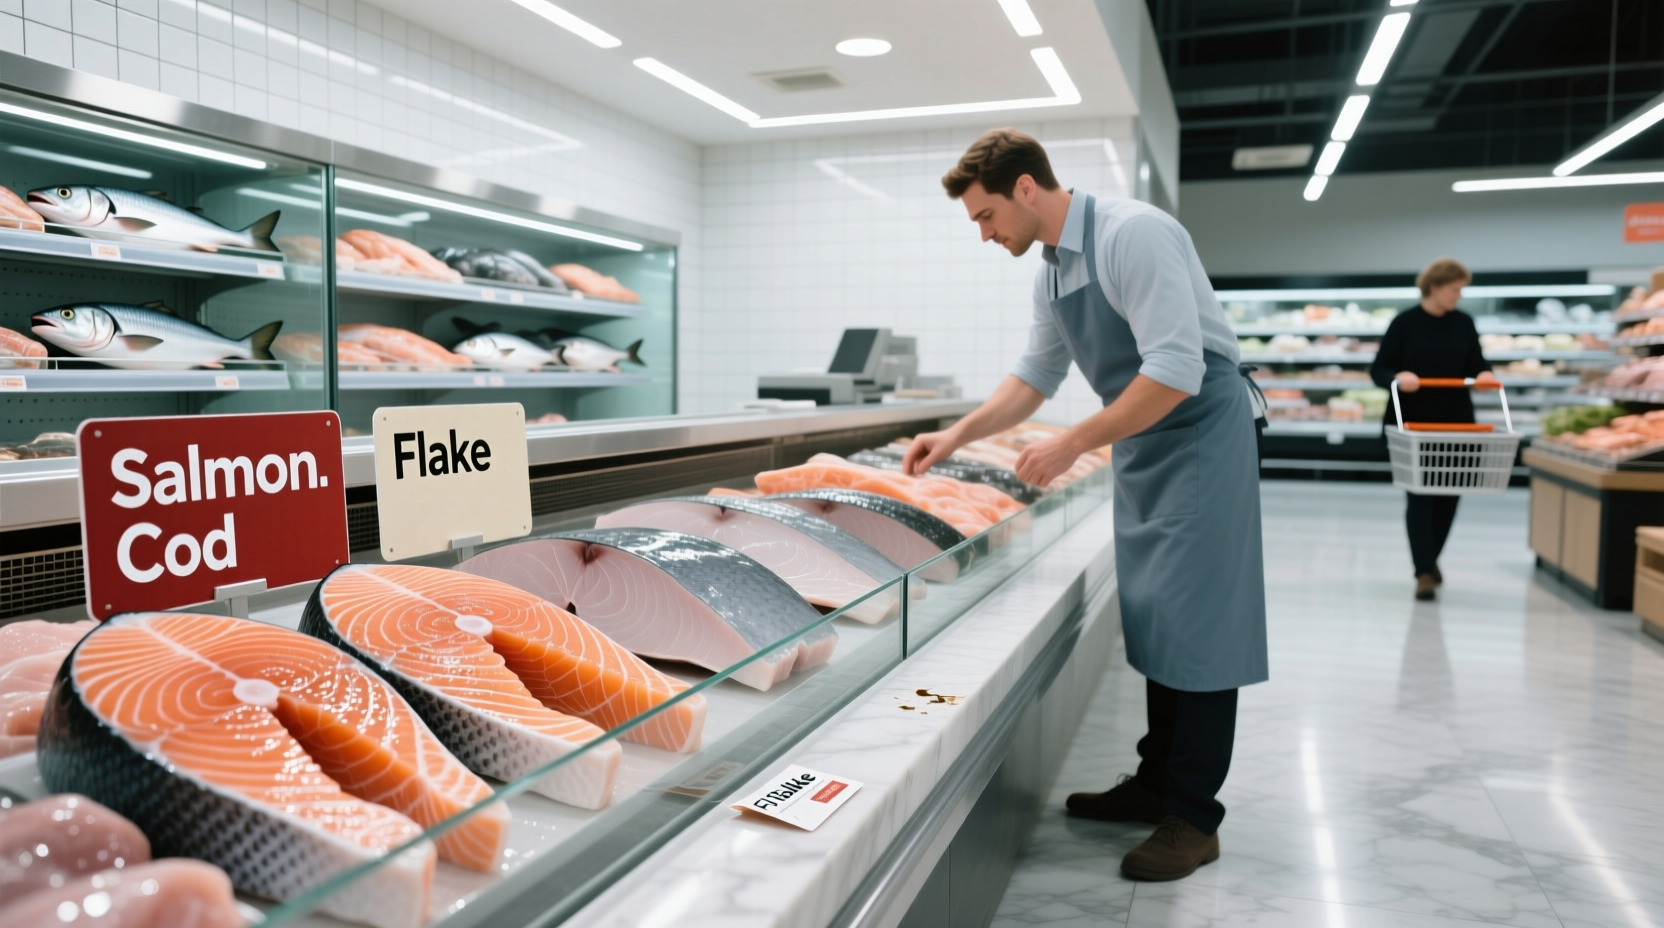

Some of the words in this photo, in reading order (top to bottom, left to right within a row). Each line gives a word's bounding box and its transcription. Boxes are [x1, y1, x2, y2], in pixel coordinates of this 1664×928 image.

[111, 443, 329, 509] Salmon.
[393, 428, 492, 480] Flake
[116, 512, 238, 583] Cod
